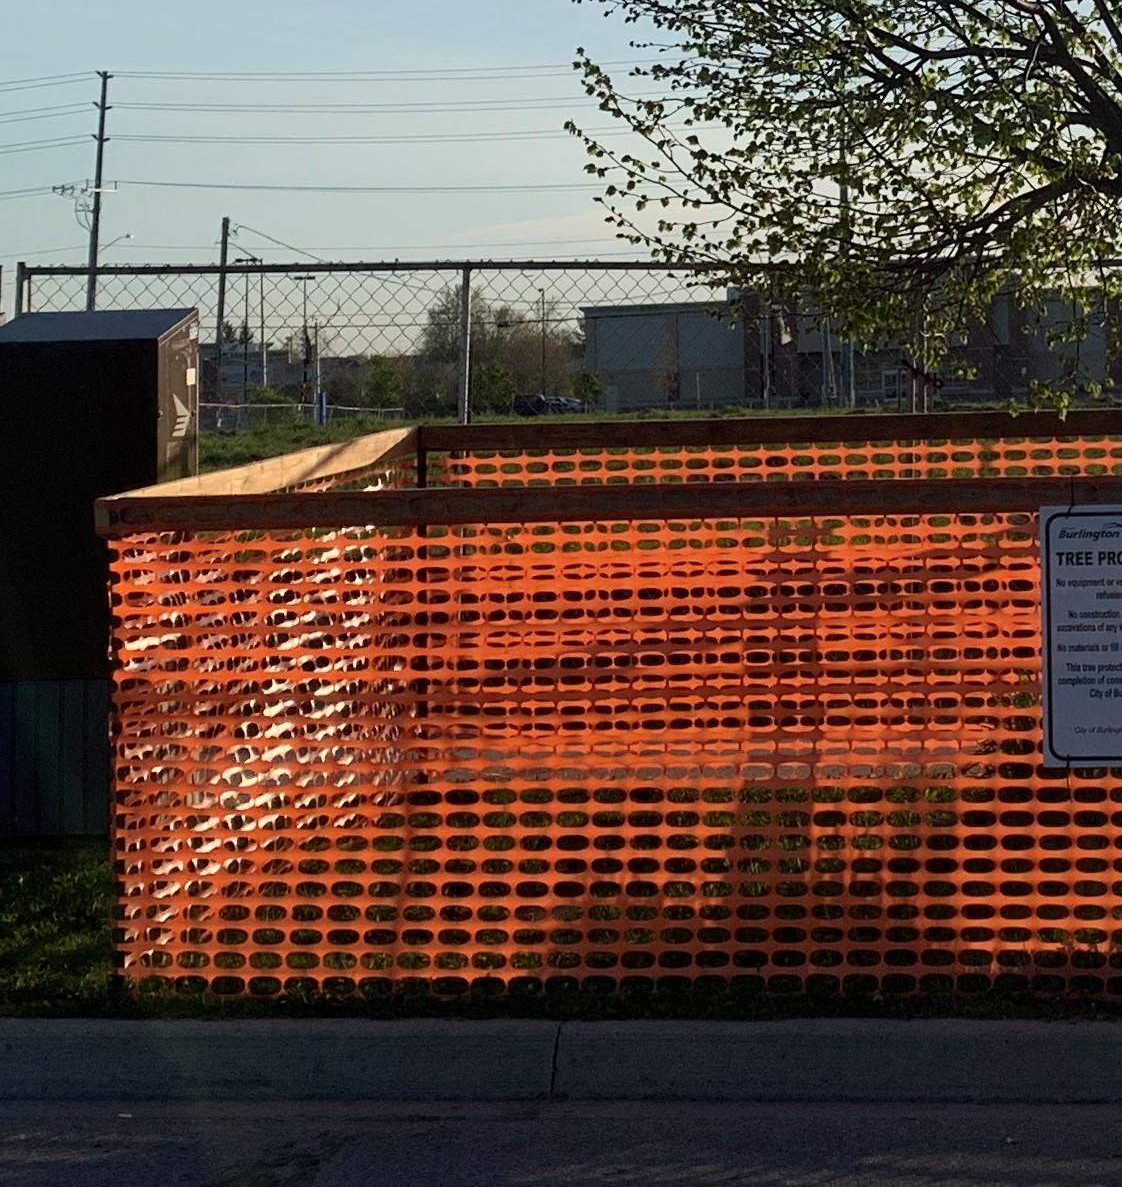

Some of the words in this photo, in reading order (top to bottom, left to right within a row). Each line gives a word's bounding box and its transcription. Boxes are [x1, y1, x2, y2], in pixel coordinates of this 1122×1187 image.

[1059, 529, 1119, 541] Burlington
[1056, 552, 1094, 567] TREE
[1068, 579, 1105, 588] equipment
[1068, 610, 1078, 618] No
[1079, 610, 1120, 618] construction
[1057, 623, 1096, 631] excavations
[1097, 623, 1105, 631] of
[1106, 625, 1118, 633] any
[1057, 644, 1067, 652] No
[1068, 644, 1100, 652] materials
[1110, 643, 1120, 651] fill
[1066, 663, 1081, 671] This
[1082, 663, 1096, 671] tree
[1058, 677, 1096, 686] completion
[1097, 676, 1105, 684] of
[1090, 690, 1103, 699] City
